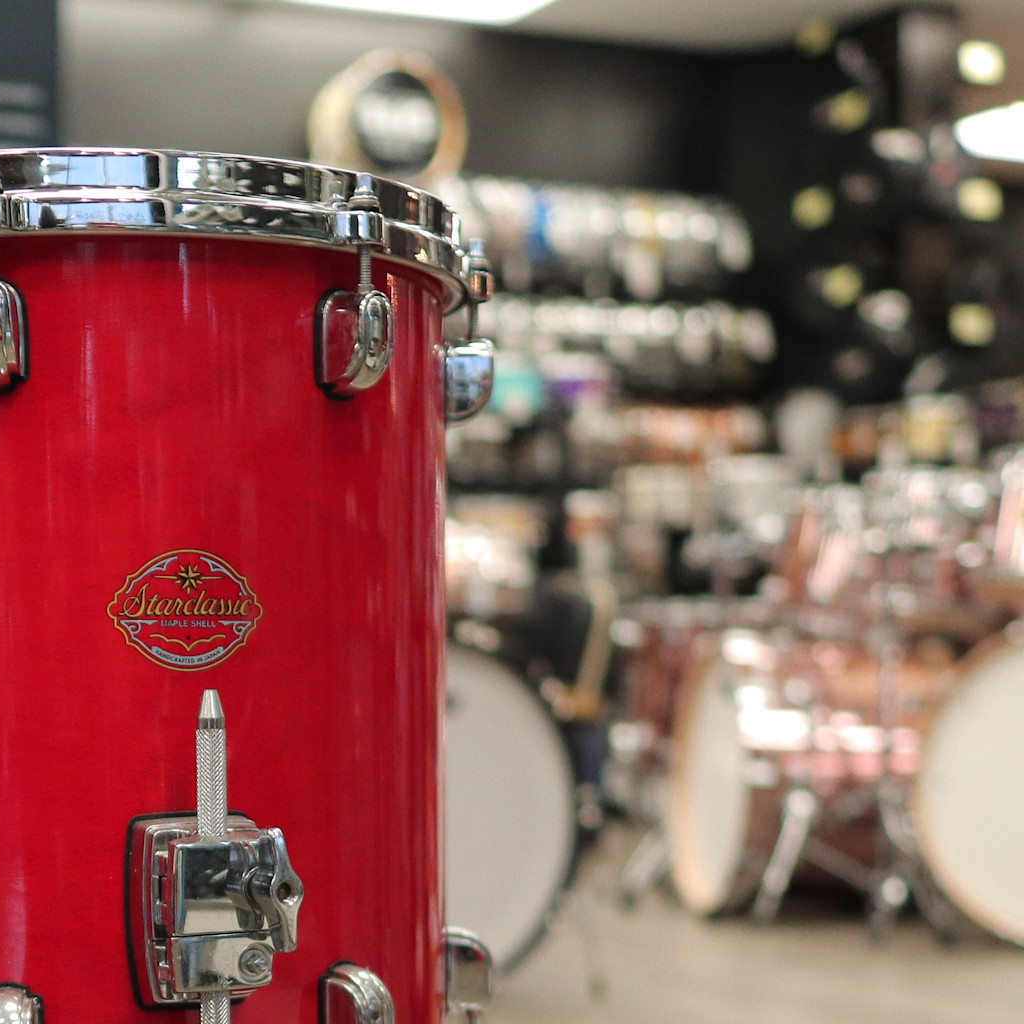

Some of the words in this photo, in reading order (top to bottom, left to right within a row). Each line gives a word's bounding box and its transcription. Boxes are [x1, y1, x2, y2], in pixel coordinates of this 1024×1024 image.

[118, 583, 252, 618] Starclassic
[191, 620, 216, 628] SHELL
[155, 649, 195, 664] HANDCRAFTED
[204, 651, 221, 662] JAPAN
